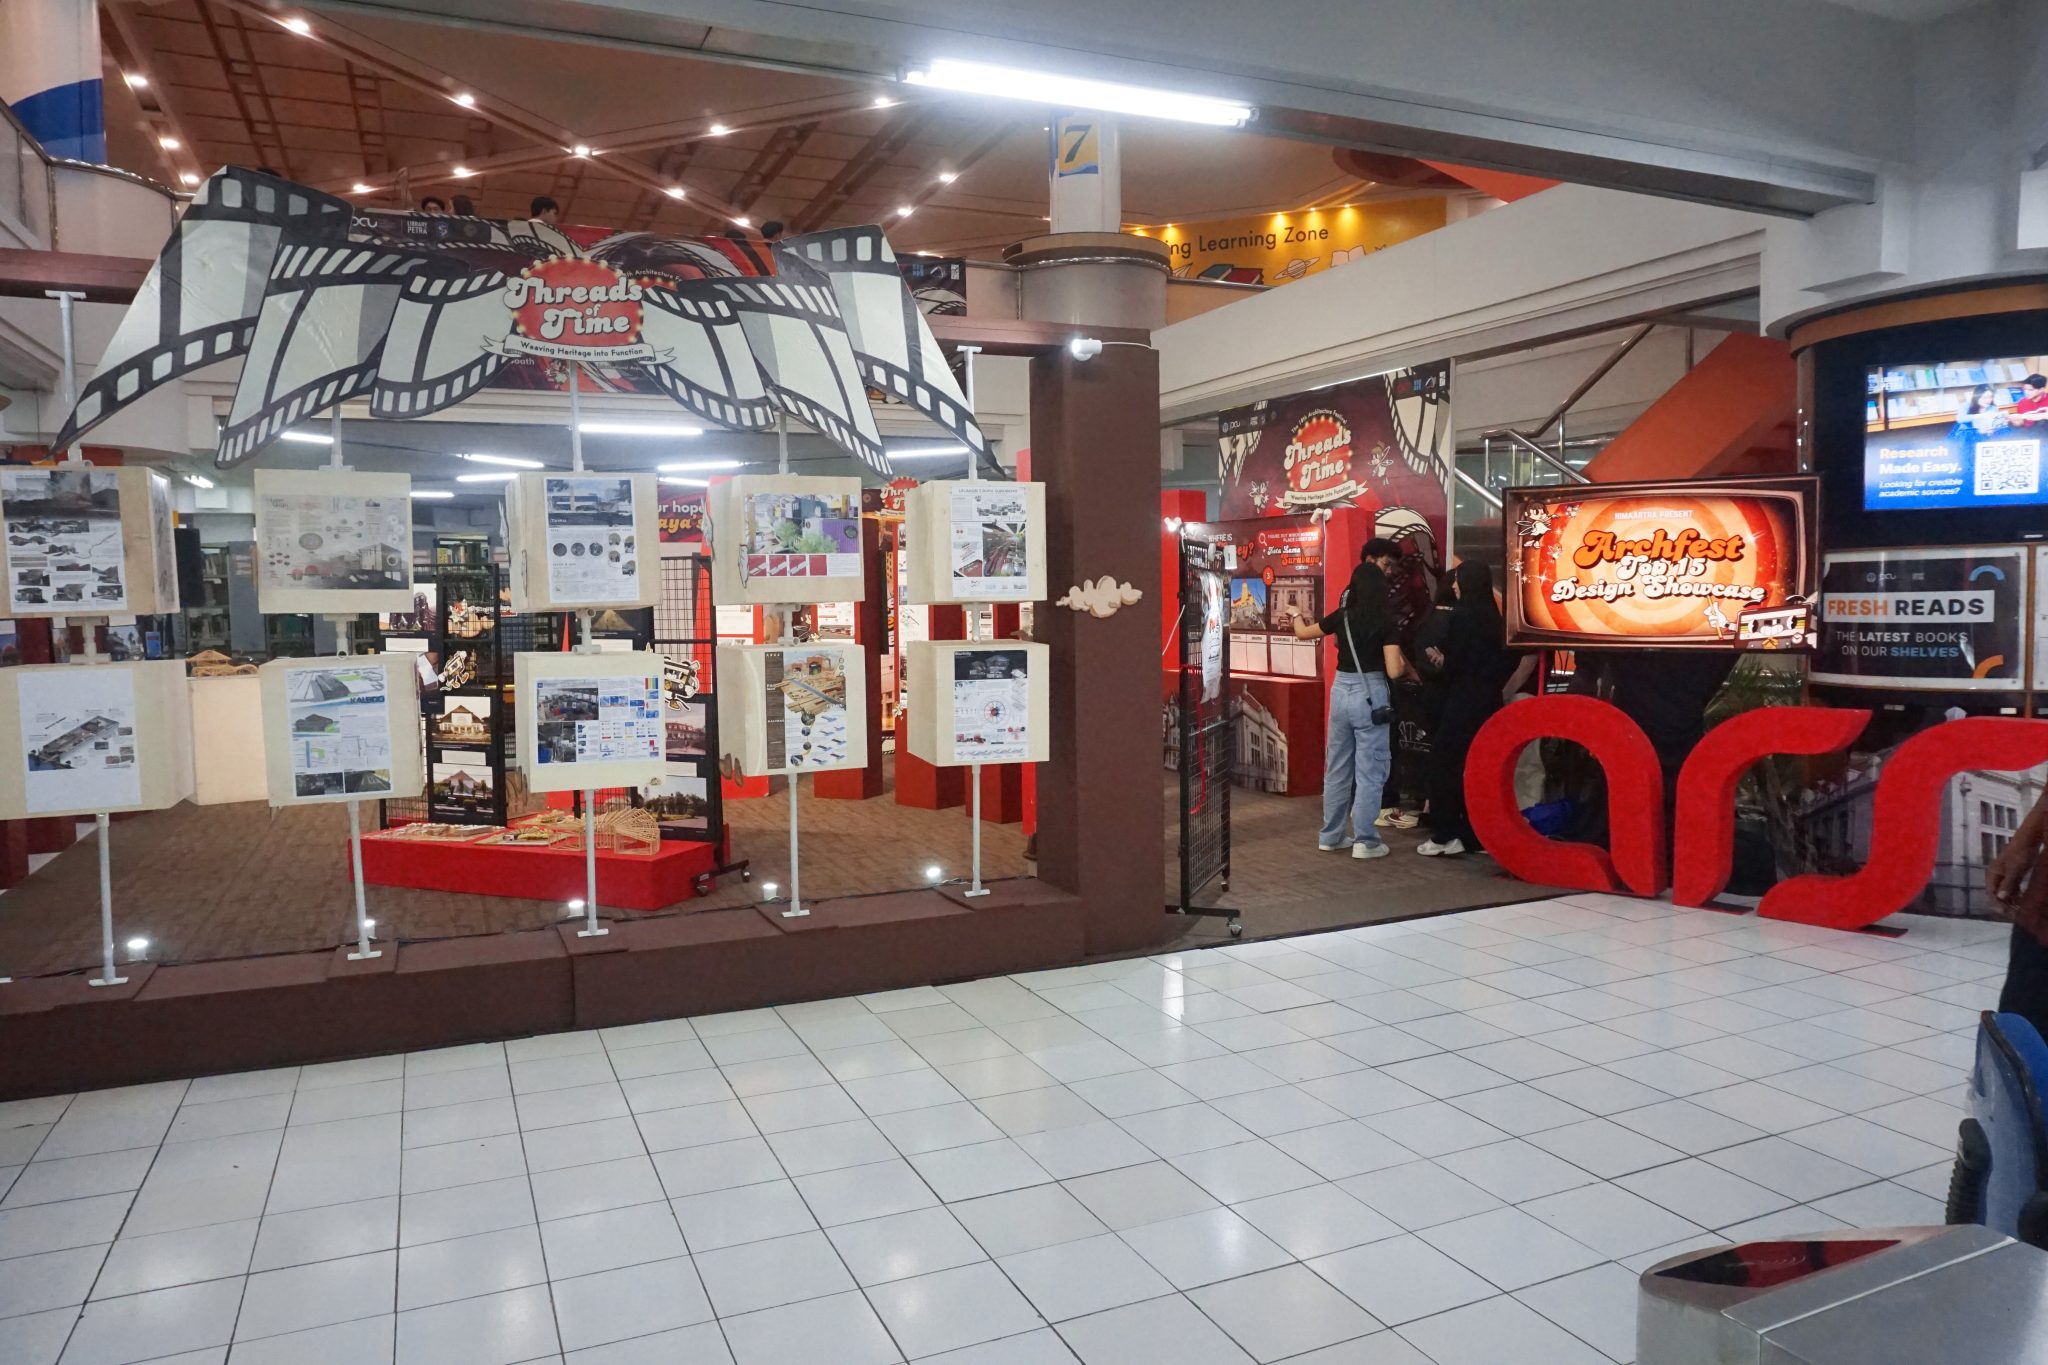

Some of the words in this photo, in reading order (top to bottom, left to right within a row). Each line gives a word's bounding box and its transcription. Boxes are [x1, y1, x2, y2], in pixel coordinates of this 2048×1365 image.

[1064, 124, 1092, 163] 7
[407, 220, 428, 228] LIBRARY
[407, 226, 428, 235] PETRA
[1199, 230, 1276, 253] Learning
[1284, 226, 1329, 244] Zone
[503, 276, 643, 309] Threads
[585, 304, 600, 317] of
[540, 308, 630, 340] Time
[521, 340, 556, 355] Weaving
[557, 346, 592, 357] Heritage
[594, 349, 609, 357] into
[612, 348, 643, 357] Function
[1284, 425, 1352, 470] Threads
[1879, 446, 1949, 460] Research
[1321, 453, 1330, 465] of
[1300, 460, 1345, 490] Time
[1879, 463, 1921, 475] Made
[1922, 460, 1963, 474] Easy.
[1879, 480, 1914, 489] Looking
[1914, 479, 1927, 487] for
[1927, 478, 1964, 486] credible
[1879, 489, 1919, 497] academic
[1921, 487, 1961, 496] sources?
[1659, 510, 1694, 519] PRESENT
[1573, 528, 1745, 570] Archfest
[1281, 554, 1320, 566] Surabaya
[1616, 553, 1671, 581] Top
[1673, 556, 1707, 577] 15
[1551, 576, 1635, 603] Design
[1640, 574, 1767, 600] Showcase
[1827, 600, 1888, 616] FRESH
[1895, 598, 1985, 616] READS
[1837, 631, 1856, 642] THE
[1859, 632, 1911, 643] LATEST
[1915, 631, 1968, 643] BOOKS
[1842, 646, 1857, 655] ON
[1861, 646, 1887, 656] OUR
[1891, 647, 1959, 657] SHELVES
